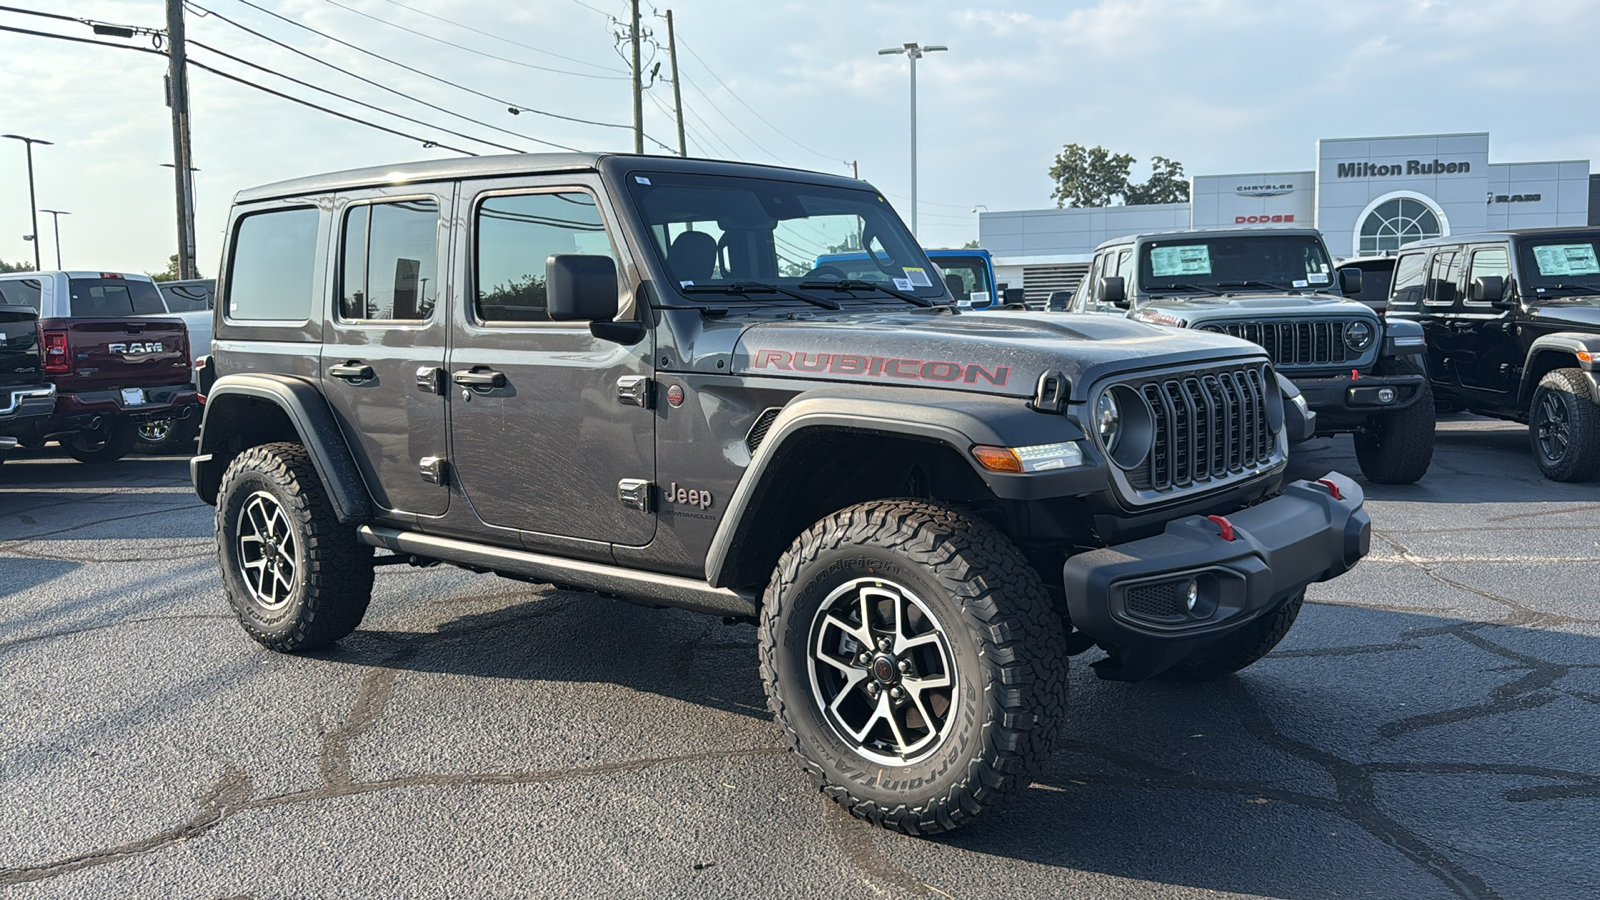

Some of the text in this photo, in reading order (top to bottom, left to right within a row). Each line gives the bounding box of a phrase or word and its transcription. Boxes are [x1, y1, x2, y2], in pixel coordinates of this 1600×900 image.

[1337, 159, 1471, 178] Milton Ruben
[1495, 194, 1541, 203] RAM
[1235, 215, 1294, 224] DODGE
[108, 342, 163, 354] RAM
[754, 349, 1011, 387] RUBICON
[664, 482, 713, 510] Jeep
[672, 511, 716, 521] WRANGLER
[783, 555, 901, 651] BFGoodrich
